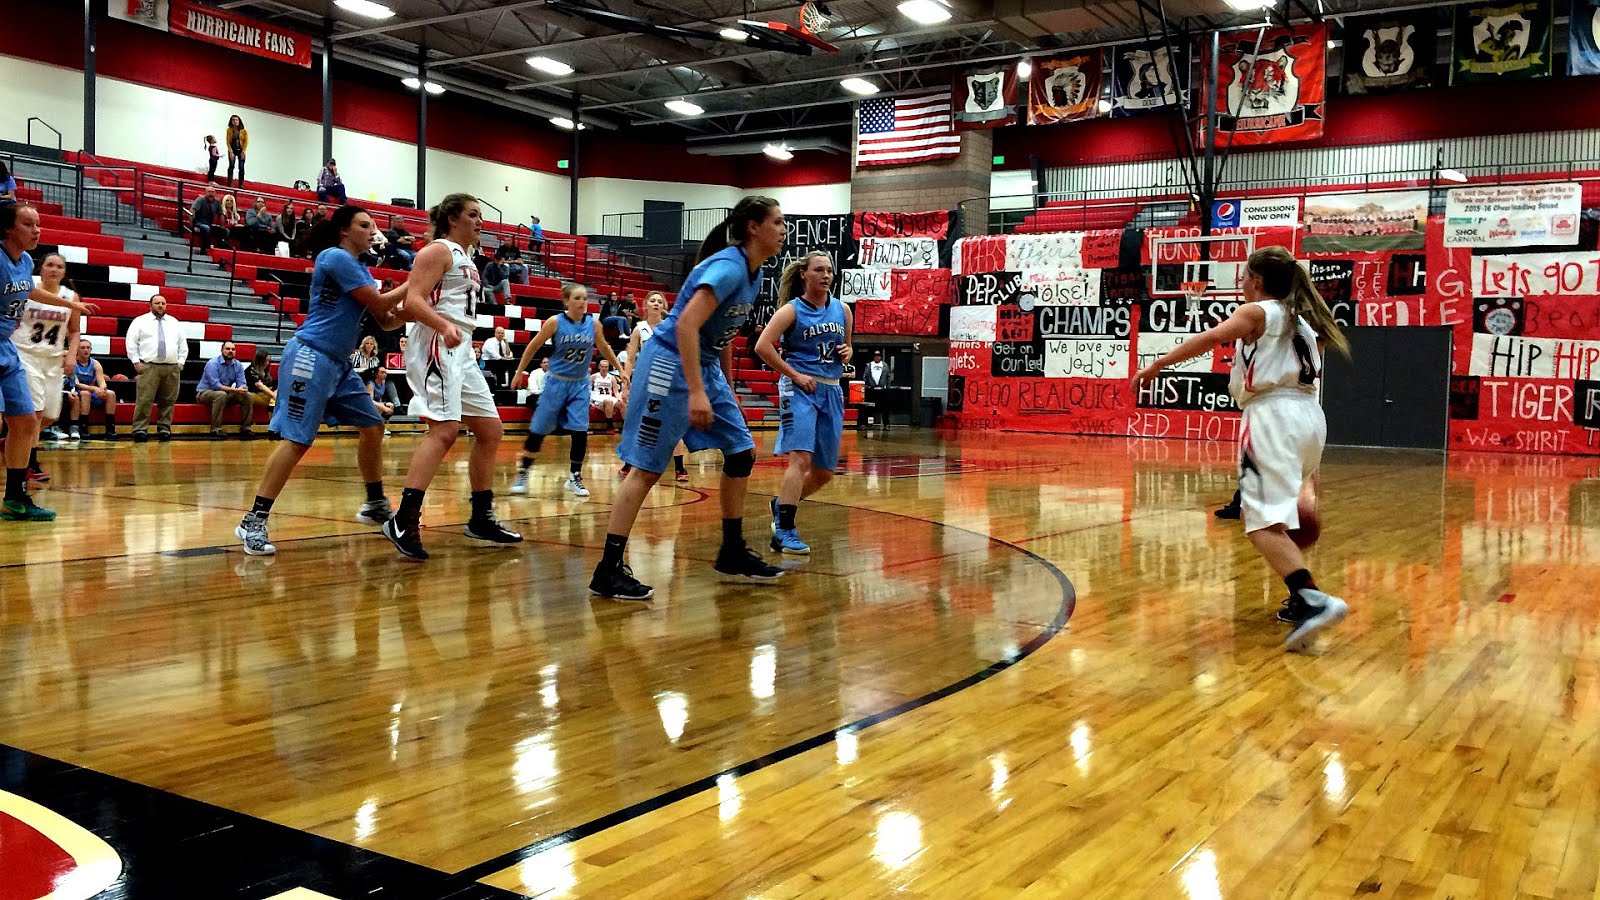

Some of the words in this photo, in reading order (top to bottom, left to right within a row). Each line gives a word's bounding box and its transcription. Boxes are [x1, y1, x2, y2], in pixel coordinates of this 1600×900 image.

[187, 10, 261, 48] HURRICANE
[264, 31, 295, 57] FANS
[1243, 204, 1296, 213] CONCESSIONS
[1147, 226, 1267, 260] HURRCANE
[842, 271, 877, 297] BOW
[966, 275, 998, 305] PEP
[990, 275, 1022, 306] CLUB
[1481, 259, 1531, 297] Lets
[30, 322, 61, 345] 34
[802, 321, 846, 341] FALCONS
[1040, 306, 1131, 337] CHAMPS
[563, 348, 589, 365] 25
[815, 340, 836, 364] 12
[1020, 344, 1034, 355] on
[1049, 341, 1068, 354] We
[1076, 341, 1102, 355] love
[1107, 343, 1131, 357] you
[1483, 381, 1574, 422] TIGER
[1126, 411, 1171, 438] RED
[1186, 414, 1242, 441] HOT
[1466, 428, 1501, 447] We
